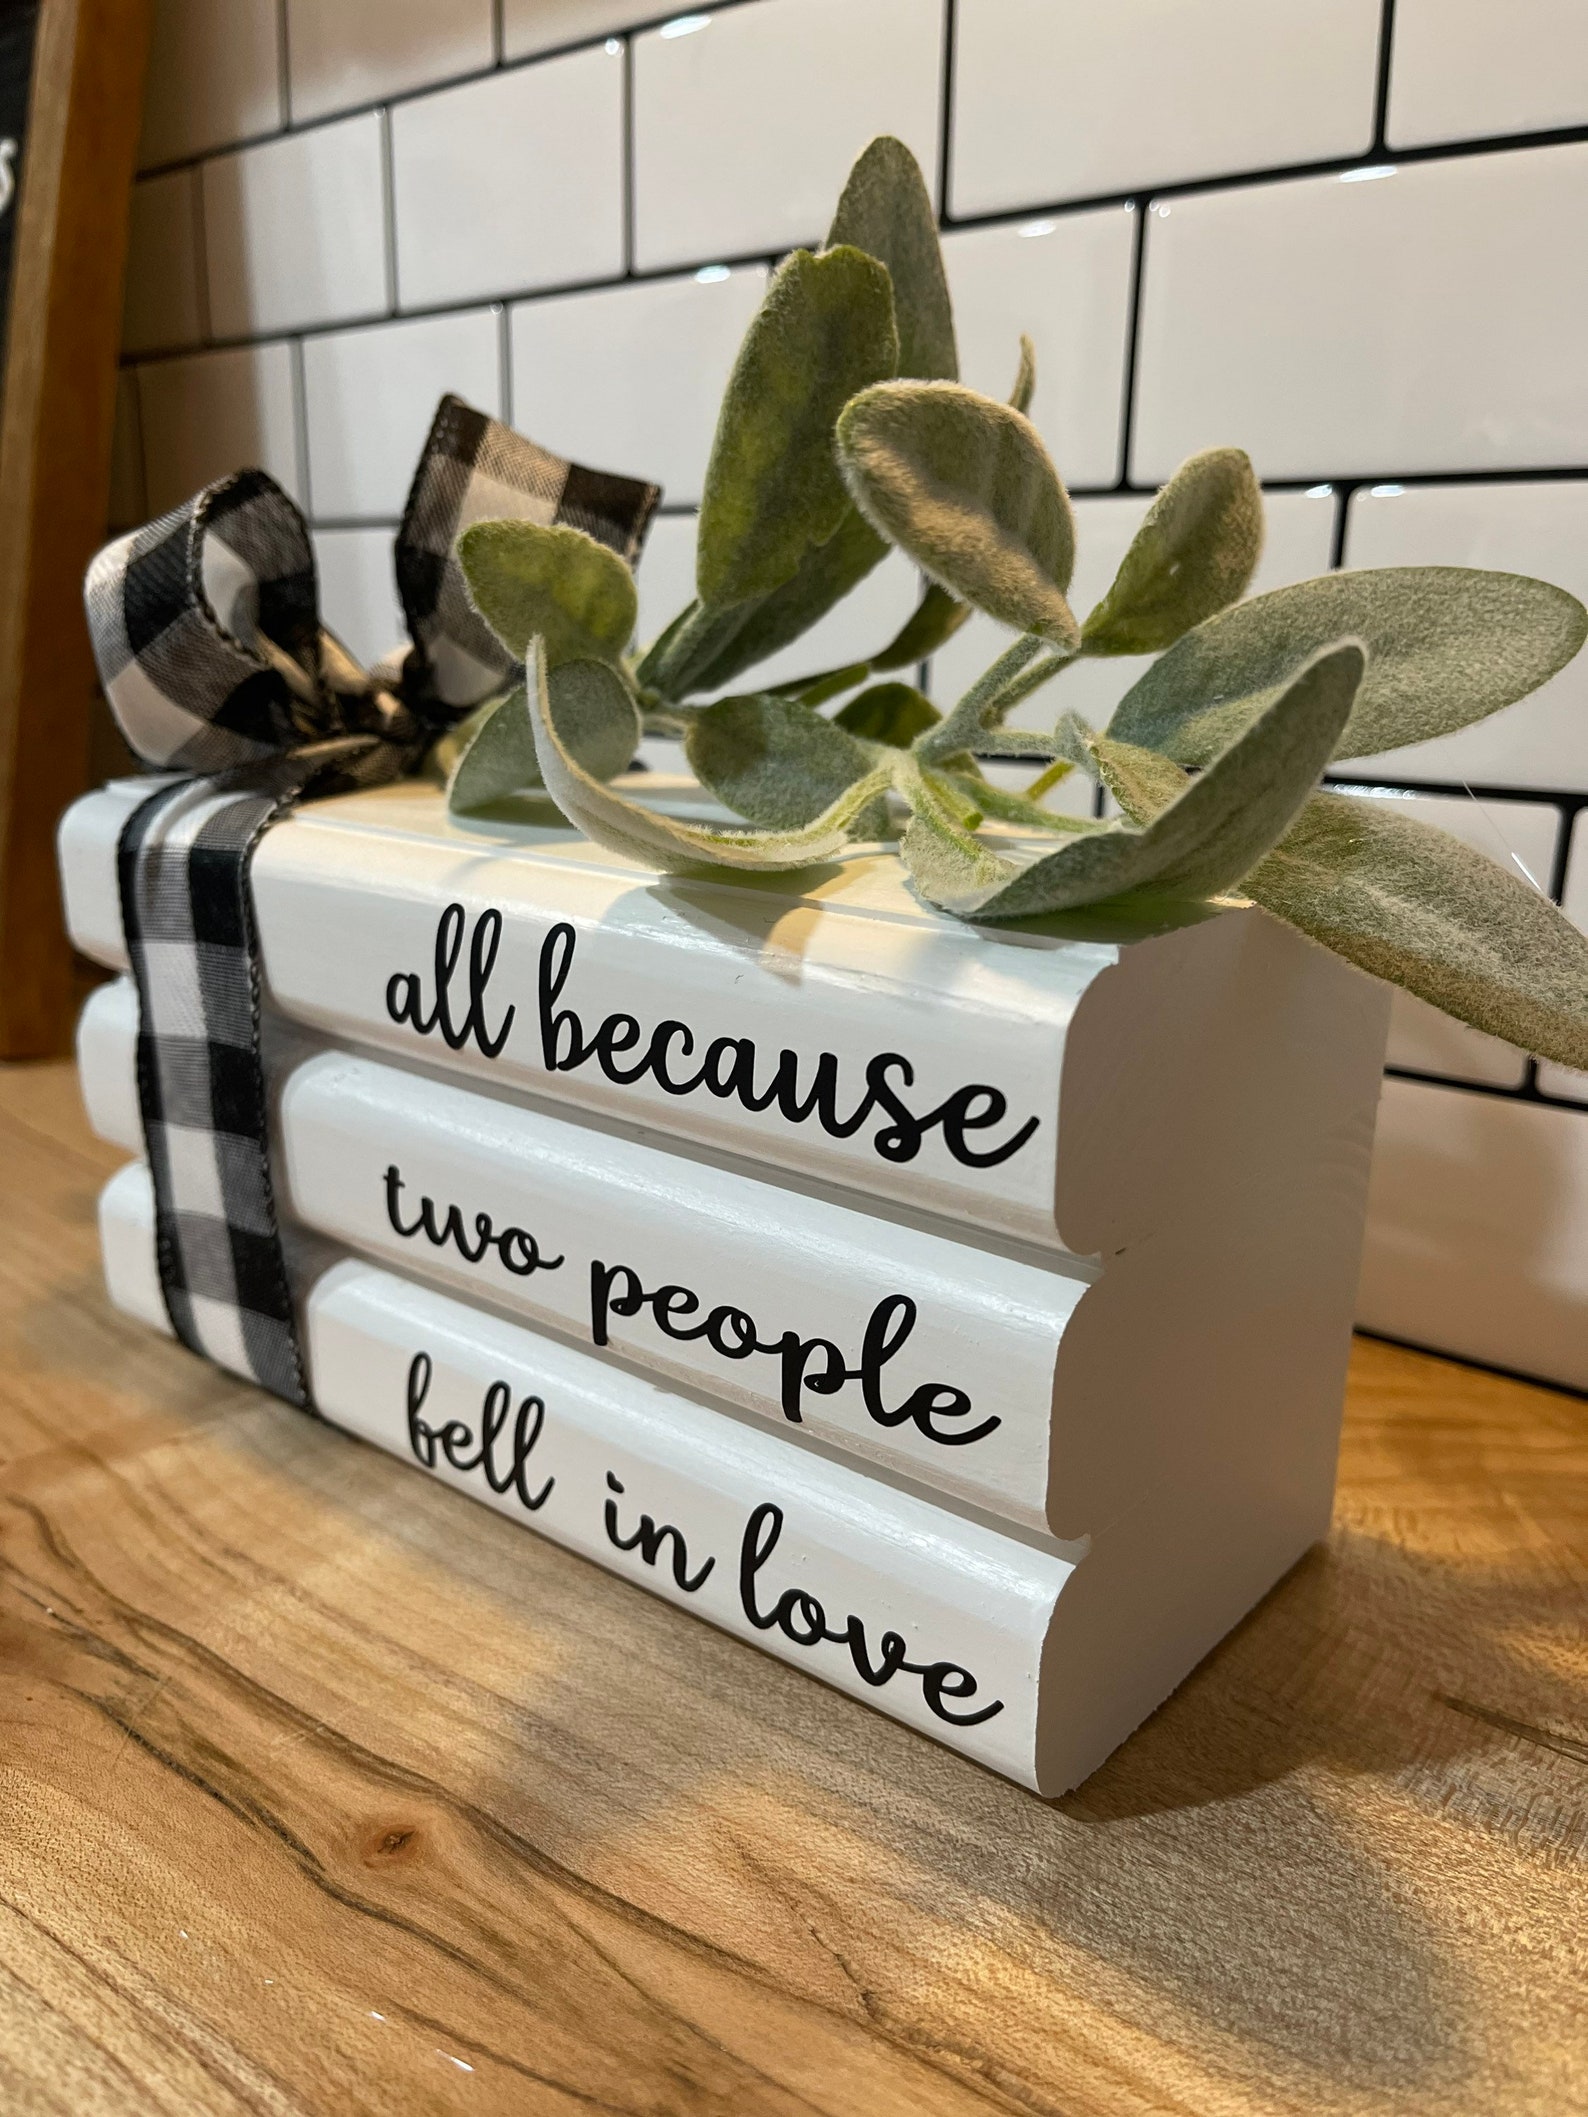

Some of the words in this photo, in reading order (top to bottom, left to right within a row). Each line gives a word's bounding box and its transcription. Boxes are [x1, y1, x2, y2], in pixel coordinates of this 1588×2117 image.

[386, 902, 516, 1059] all
[538, 922, 1040, 1169] because
[383, 1165, 565, 1276] two
[590, 1259, 1002, 1446] people
[604, 1471, 716, 1593] in
[739, 1502, 1005, 1727] love
